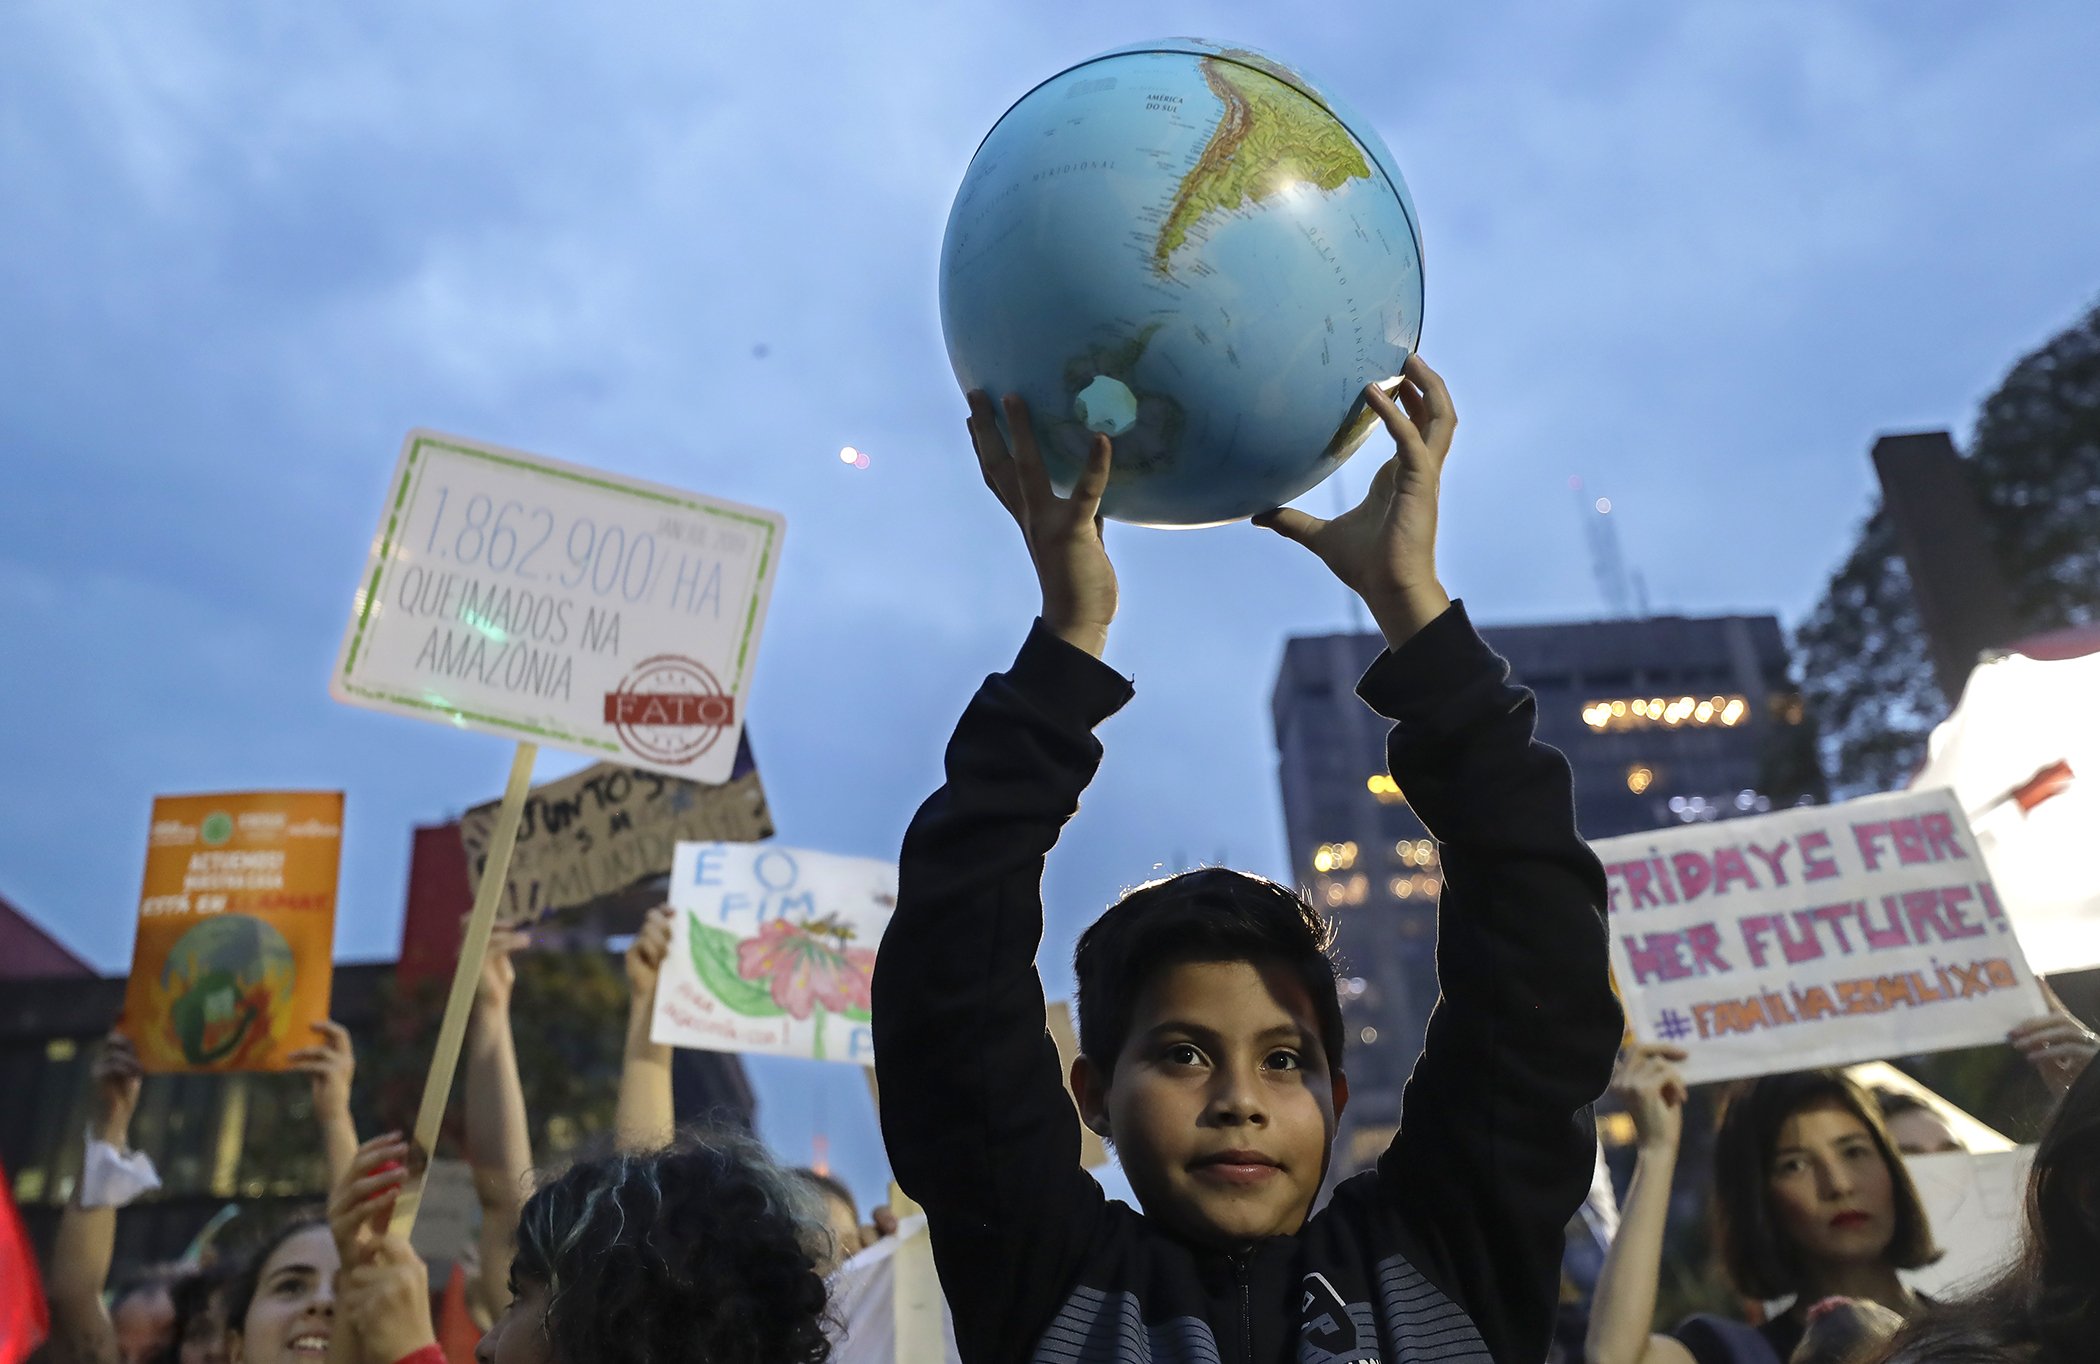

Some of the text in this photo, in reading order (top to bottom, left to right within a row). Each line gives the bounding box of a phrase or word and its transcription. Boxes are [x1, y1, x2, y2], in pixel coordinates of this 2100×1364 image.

[1162, 104, 1177, 113] SUL
[399, 566, 620, 657] QUEIMADOS NA
[616, 696, 729, 725] FATO
[1852, 812, 1968, 871] FOR
[720, 889, 816, 922] FIM
[1624, 883, 2008, 985] HER FUTURE!
